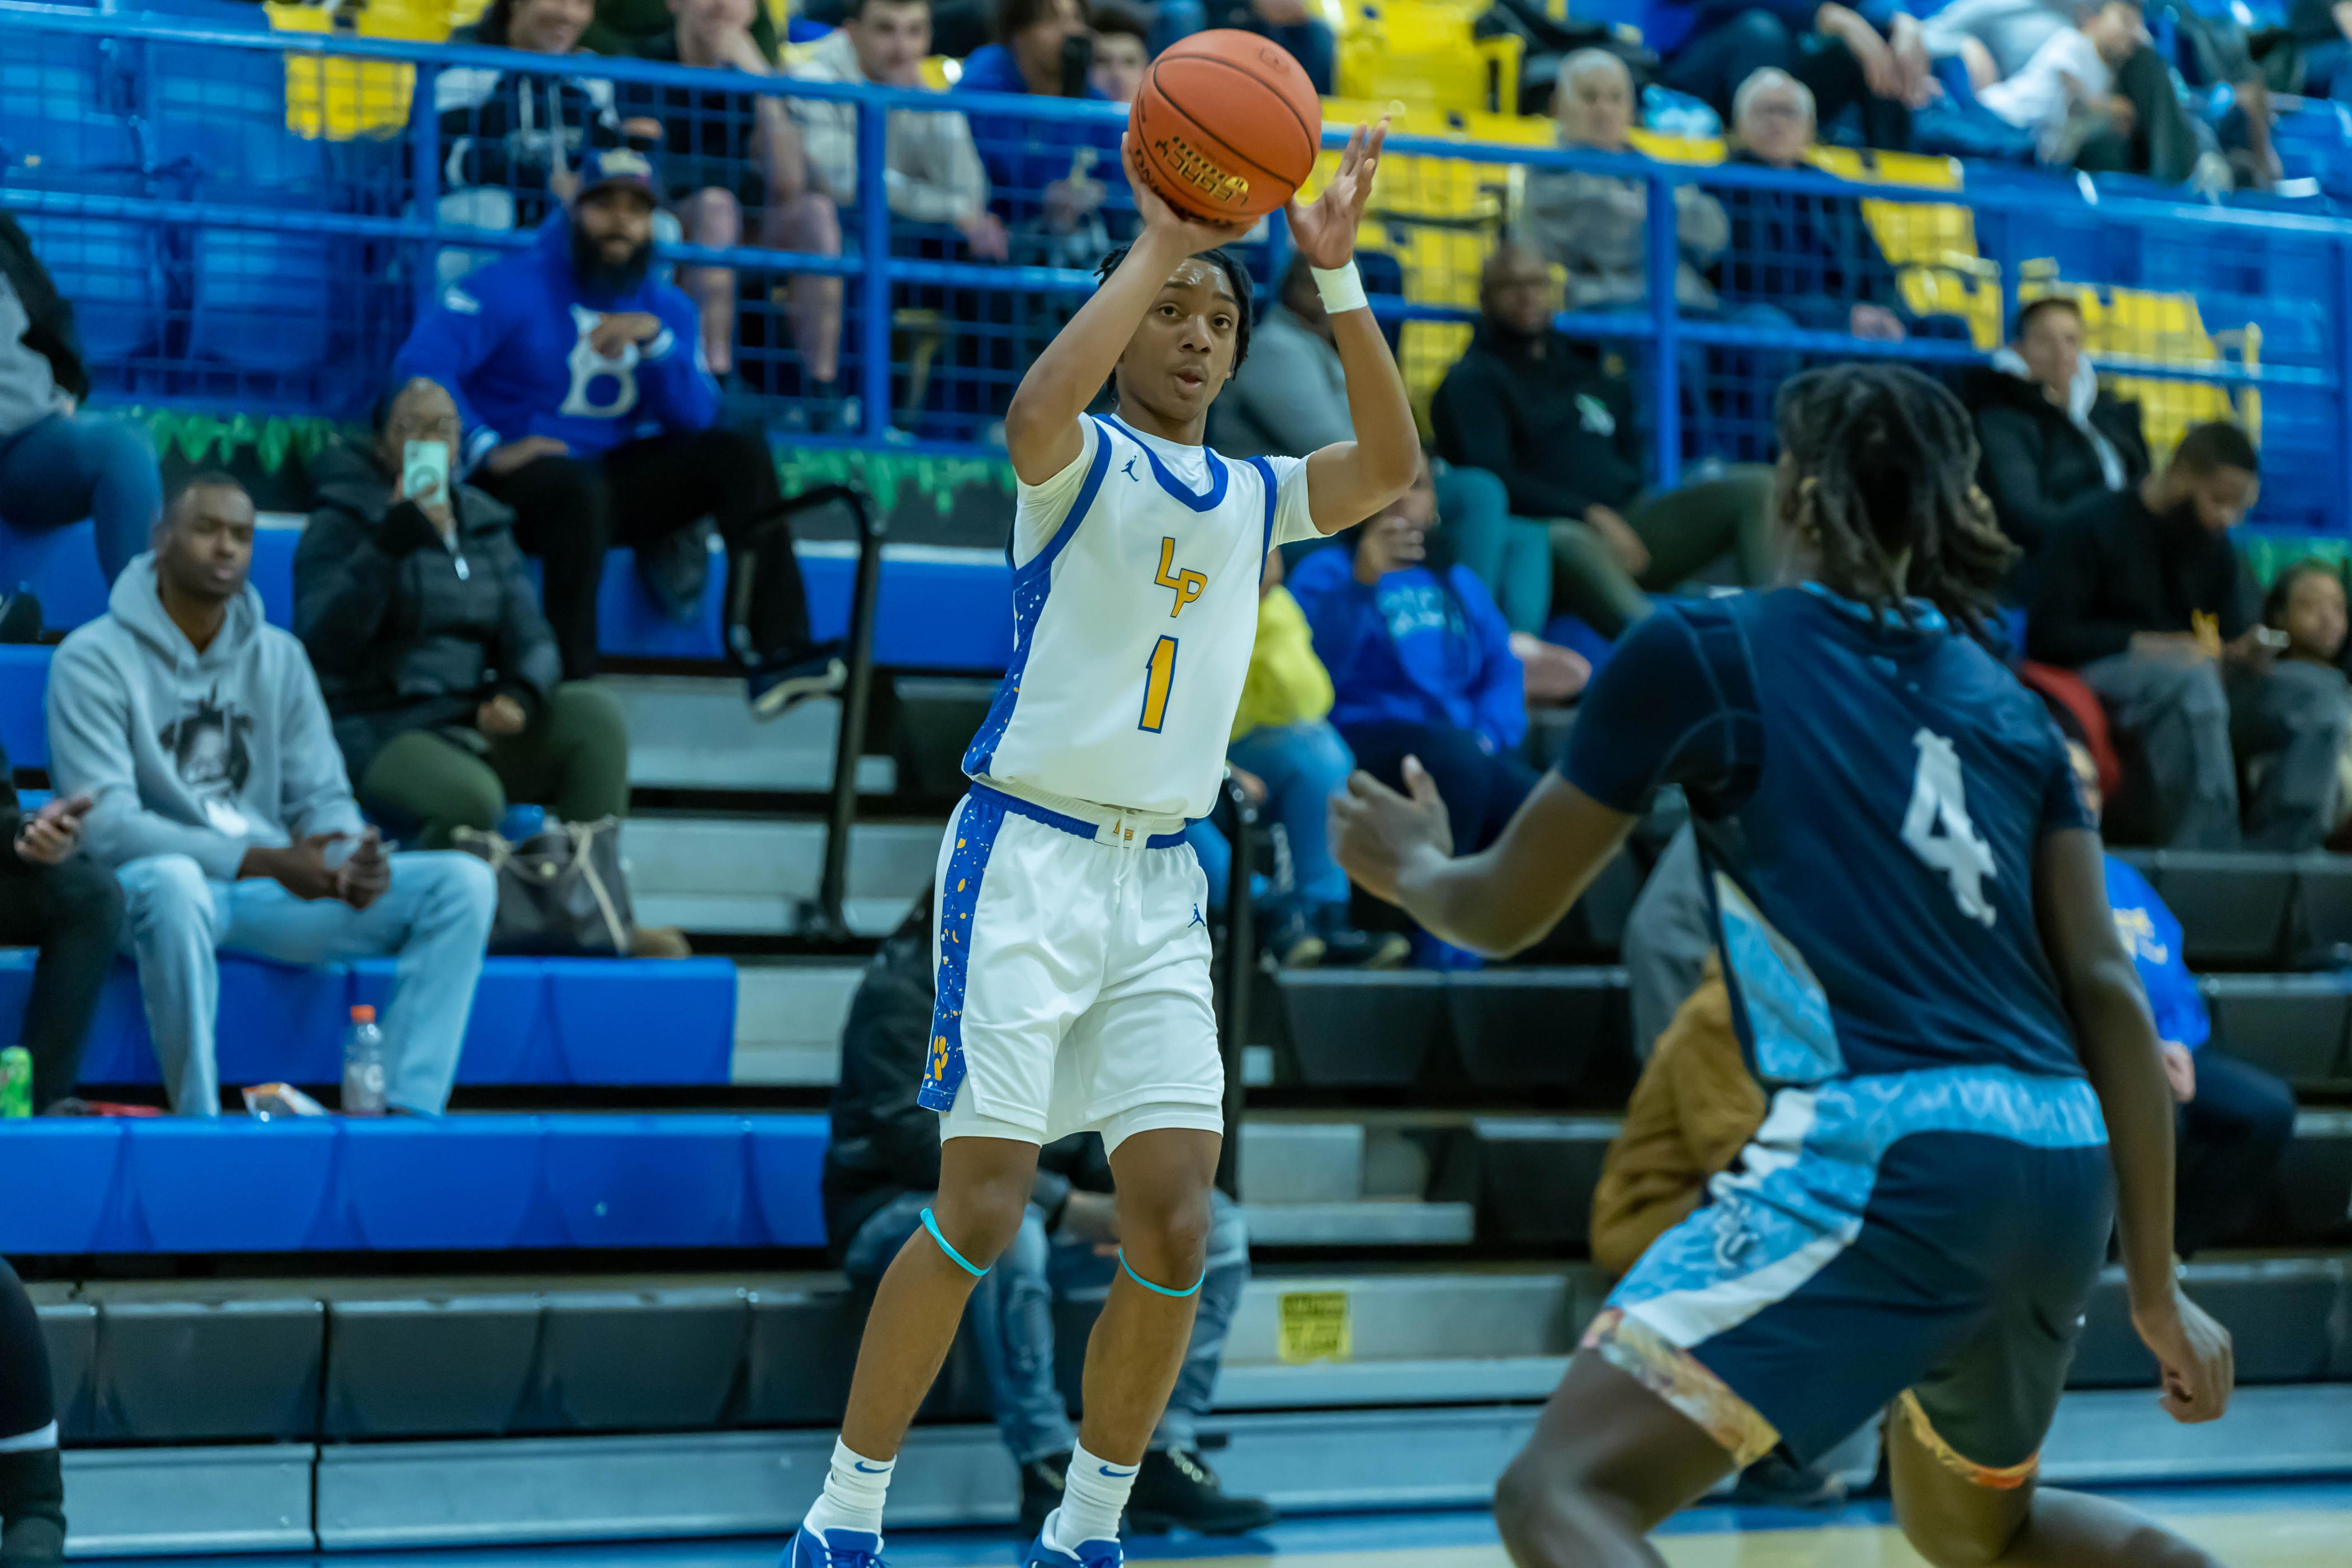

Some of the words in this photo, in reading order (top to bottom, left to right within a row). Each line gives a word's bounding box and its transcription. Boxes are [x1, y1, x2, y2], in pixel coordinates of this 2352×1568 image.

[1155, 138, 1249, 207] LEGACY
[1154, 536, 1208, 618] LP
[1137, 634, 1179, 734] 1
[1900, 726, 1998, 929] 4
